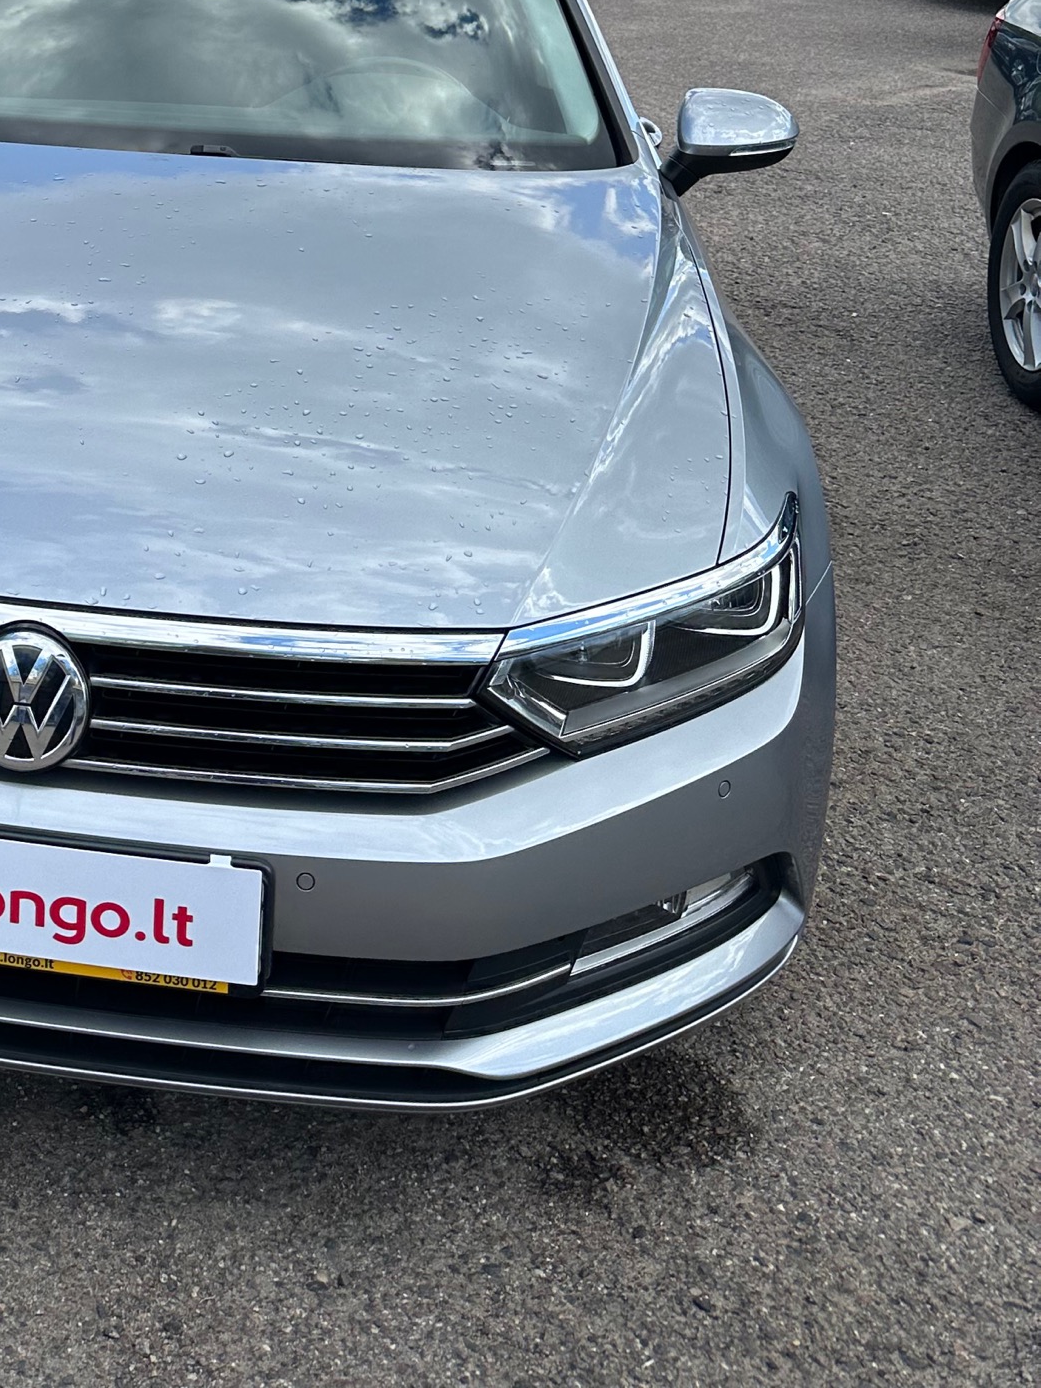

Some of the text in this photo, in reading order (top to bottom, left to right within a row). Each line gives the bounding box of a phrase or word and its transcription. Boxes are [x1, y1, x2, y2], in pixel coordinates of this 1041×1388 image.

[135, 971, 217, 990] 852 030 012
